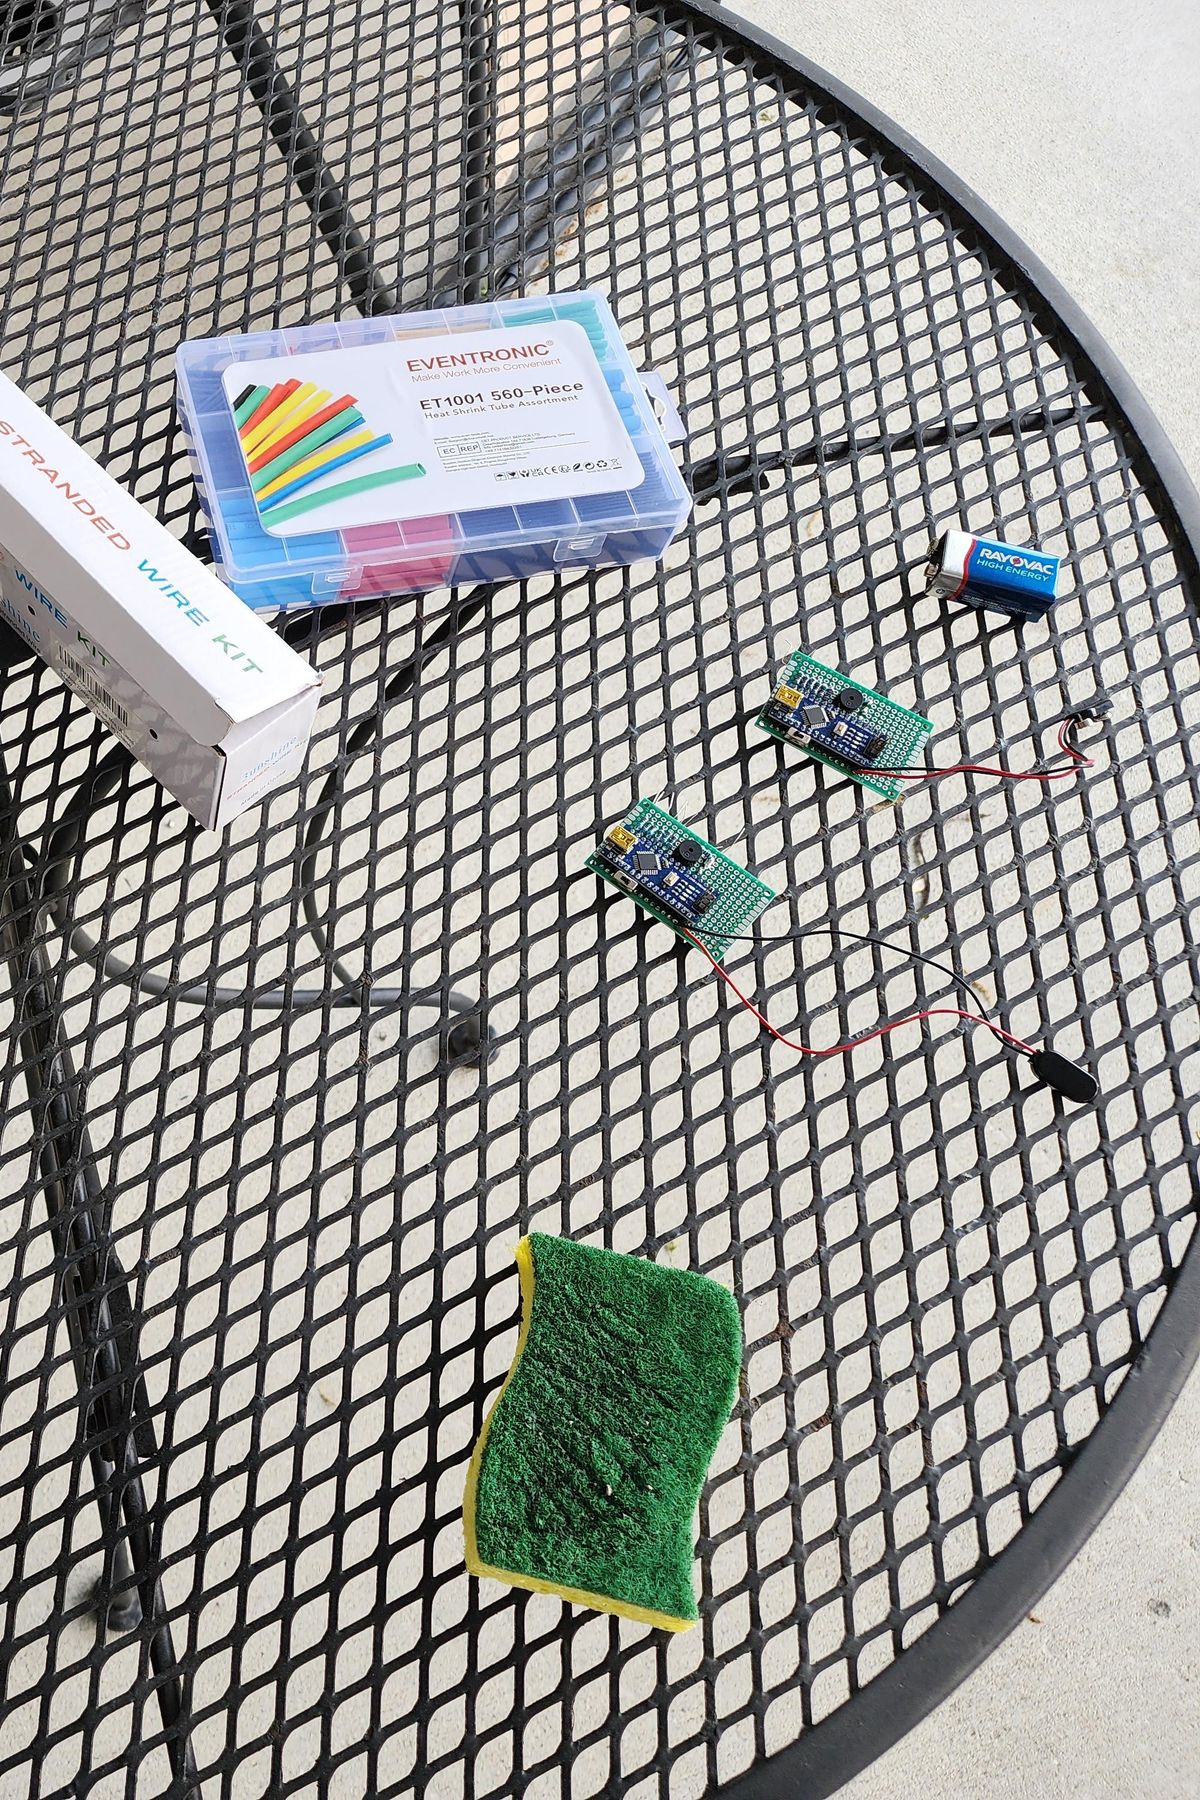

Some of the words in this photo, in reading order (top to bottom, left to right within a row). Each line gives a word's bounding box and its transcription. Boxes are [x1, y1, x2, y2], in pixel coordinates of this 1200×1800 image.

[411, 373, 441, 383] Make
[443, 369, 472, 379] Work
[473, 366, 500, 375] More
[503, 357, 562, 371] Convenient
[419, 392, 484, 410] ET1001
[491, 382, 584, 402] 560-Piece
[424, 410, 450, 420] Heat
[452, 405, 487, 416] Shrink
[488, 401, 515, 411] Tube
[518, 394, 579, 408] Assortment
[442, 447, 456, 455] EC
[460, 444, 479, 453] REP
[976, 558, 1004, 571] HIGH
[1005, 566, 1049, 581] ENERGY
[980, 548, 1054, 576] RAYOVAC
[15, 569, 68, 629] WIRE
[77, 630, 111, 666] KIT
[137, 559, 211, 626] WIRE
[211, 634, 263, 673] KIT
